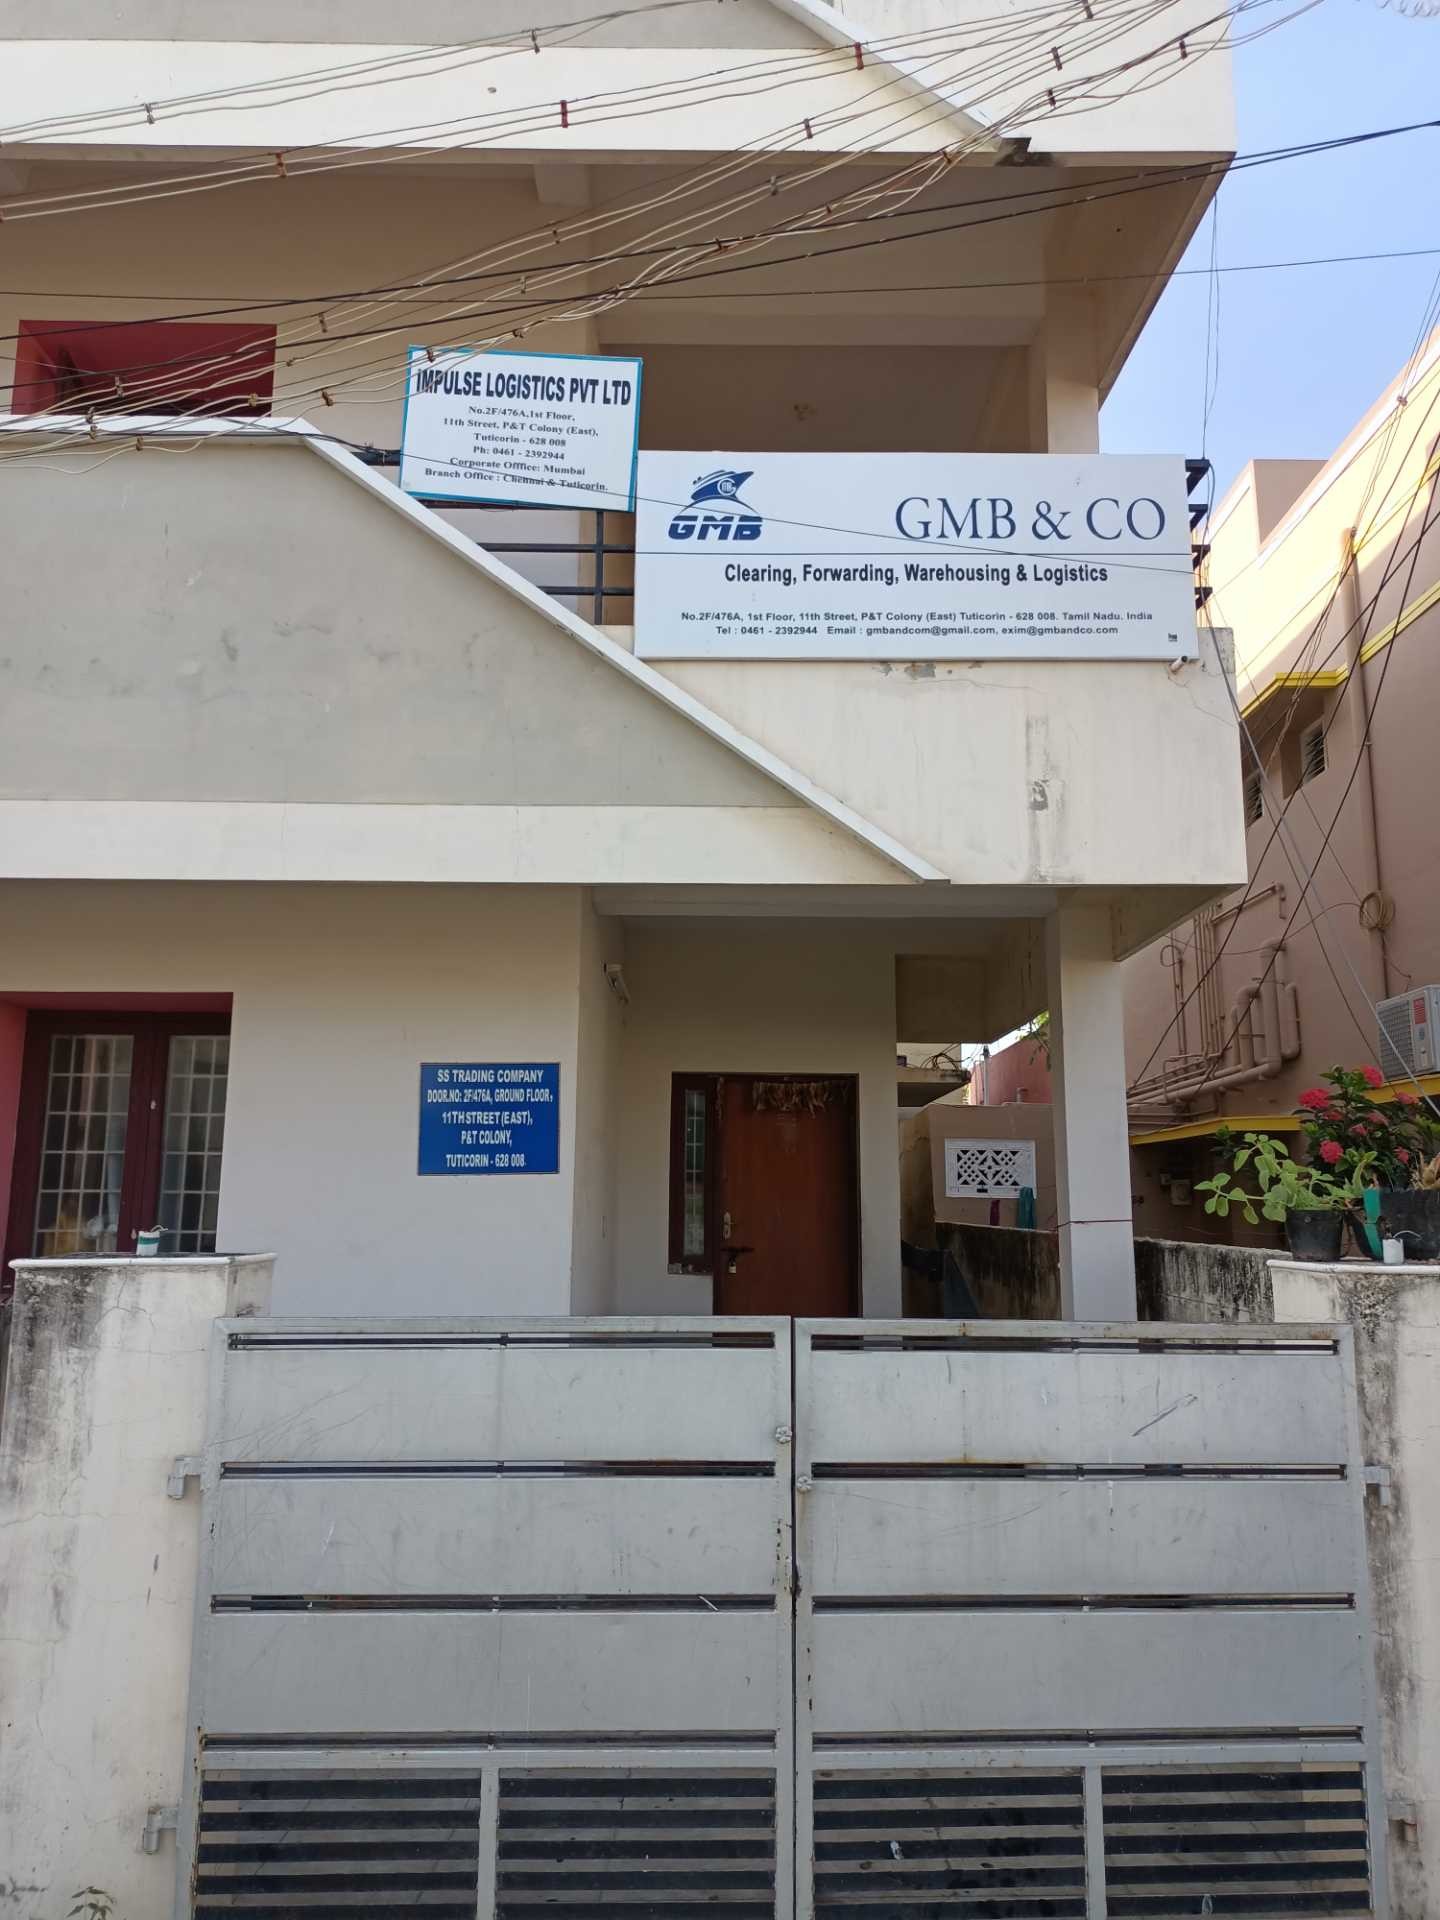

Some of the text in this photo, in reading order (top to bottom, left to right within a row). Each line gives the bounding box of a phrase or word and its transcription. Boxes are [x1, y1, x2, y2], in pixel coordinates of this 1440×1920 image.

[416, 369, 631, 405] IMPULSE LOGISTICS PVT LTD
[444, 418, 464, 426] 11th
[503, 421, 526, 431] P&T
[529, 423, 563, 435] Colony
[474, 432, 520, 443] Tuticorin
[529, 437, 546, 446] 628
[549, 438, 566, 447] 008
[473, 446, 490, 455] Ph:
[492, 447, 514, 457] 0461
[525, 449, 565, 460] 2392944
[450, 457, 501, 469] Corporate
[543, 464, 586, 475] Mumbai
[425, 467, 461, 478] Branch
[464, 471, 494, 481] Office
[503, 473, 544, 486] Chennai
[547, 478, 556, 487] &
[895, 496, 1165, 541] GMB & CO
[668, 515, 763, 541] GMB
[725, 564, 1108, 586] Clearing, Forwarding, Warehousing & Logistics
[681, 611, 743, 623] No.2F/476A,
[748, 612, 763, 622] 1st
[765, 612, 796, 623] Floor,
[799, 612, 821, 622] 11th
[824, 612, 858, 623] Street,
[861, 612, 882, 622] P&T
[886, 612, 922, 624] Colony
[926, 611, 957, 624] (East)
[960, 611, 1006, 622] Tuticorin
[1016, 612, 1034, 622] 628
[1063, 611, 1090, 622] Tamil
[1127, 611, 1153, 622] India
[717, 626, 731, 636] Tel
[740, 626, 765, 636] 0461
[775, 626, 818, 636] 2392944
[827, 625, 856, 636] Email
[866, 625, 998, 637] gmbandcom@gmail.com,
[1001, 625, 1118, 637] exim@gmbandco.com
[437, 1069, 544, 1083] SS TRADING COMPANY
[494, 1089, 525, 1102] GROUND
[526, 1088, 553, 1102] FLOOR,
[501, 1110, 533, 1127] (EAST),
[461, 1130, 512, 1147] P&T COLONY,
[446, 1154, 489, 1167] TUTICORIN
[495, 1154, 509, 1167] 628
